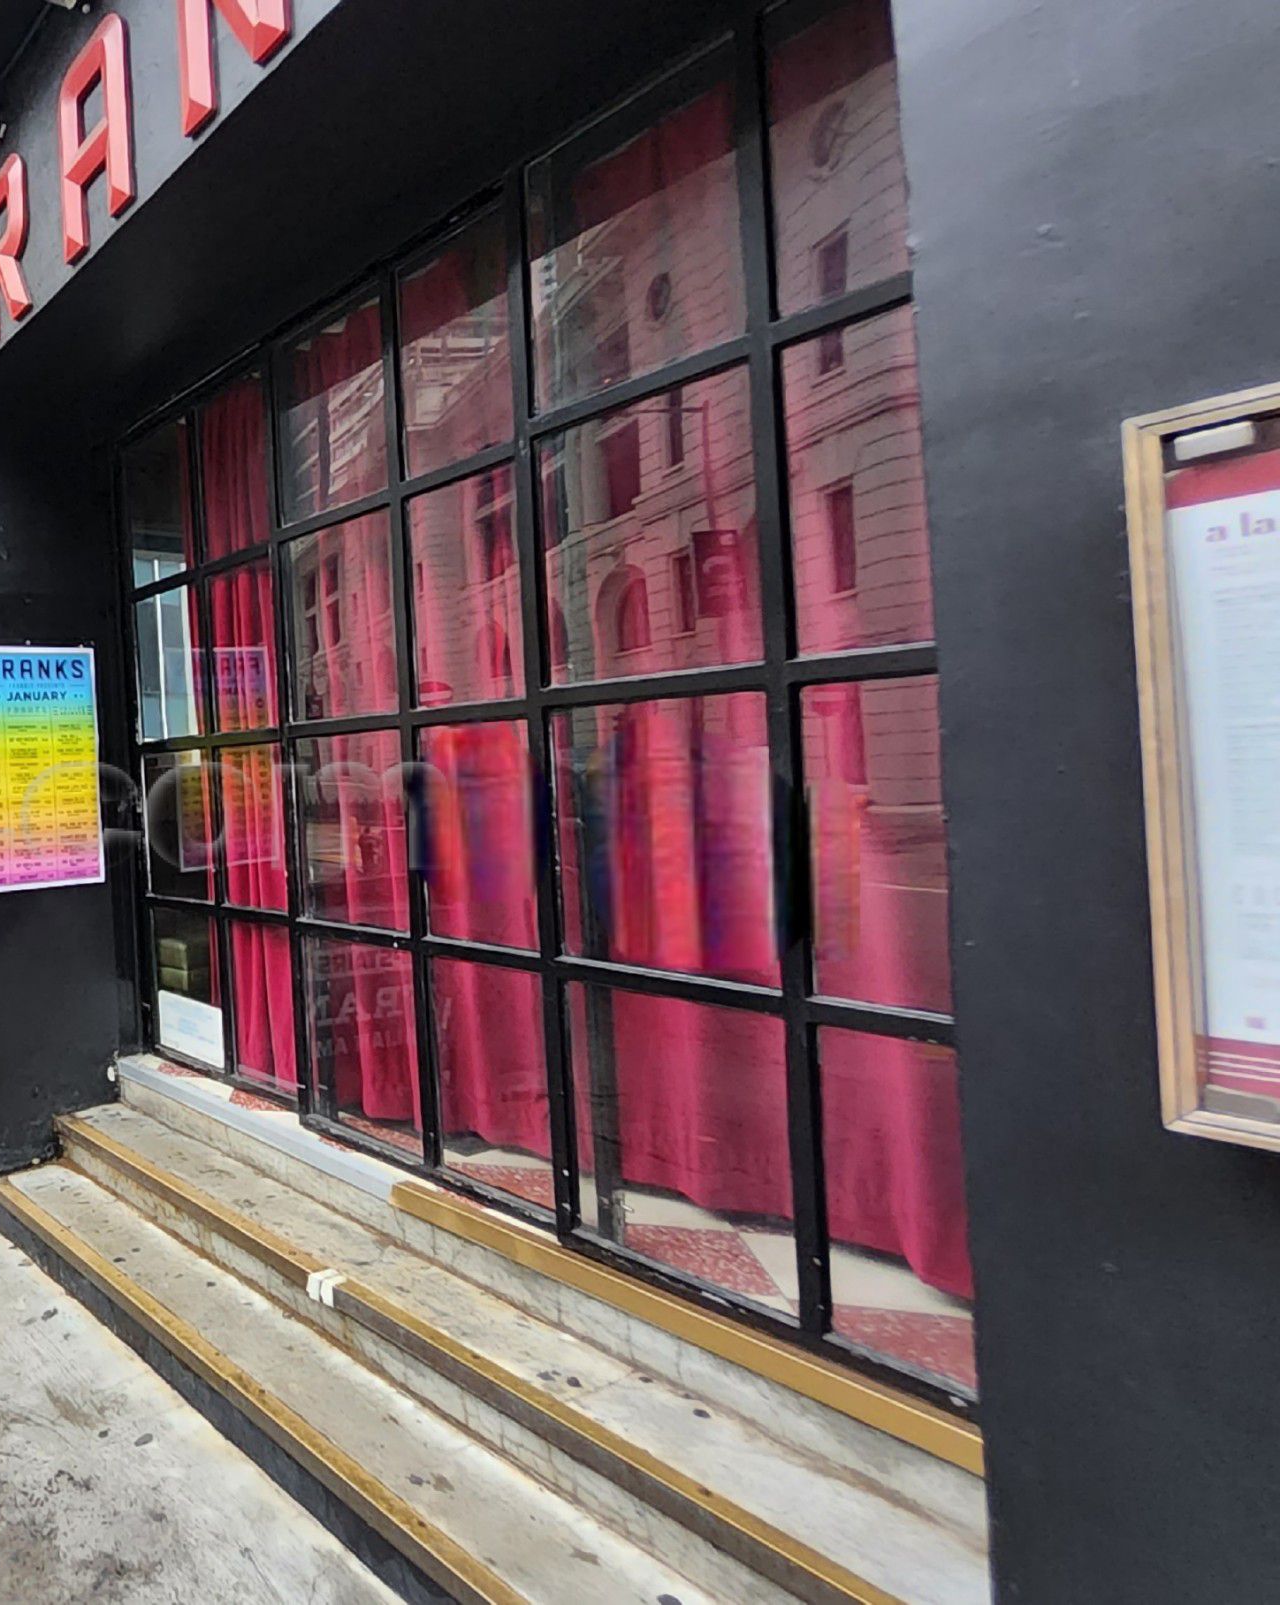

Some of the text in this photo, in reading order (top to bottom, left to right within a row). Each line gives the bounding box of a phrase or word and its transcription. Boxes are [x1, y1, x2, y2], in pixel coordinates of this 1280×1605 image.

[1205, 511, 1276, 543] a la
[6, 691, 67, 702] JANUARY
